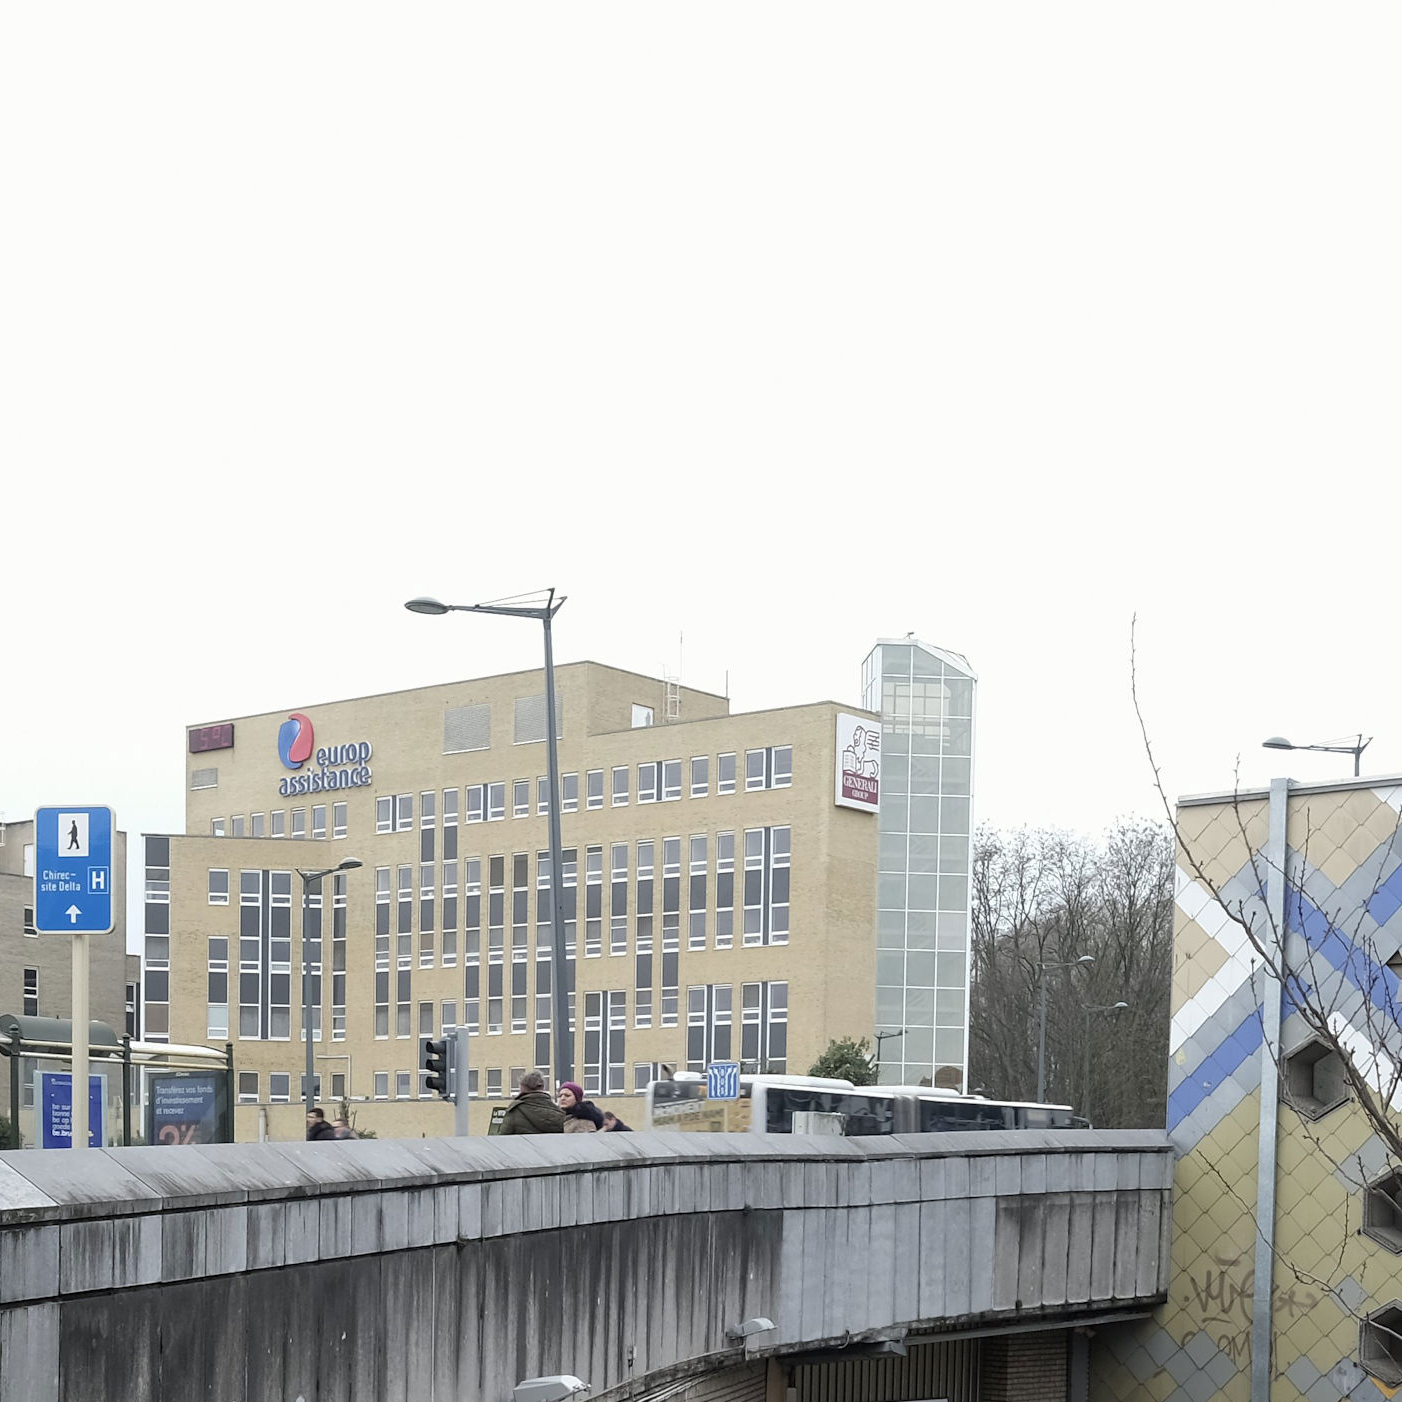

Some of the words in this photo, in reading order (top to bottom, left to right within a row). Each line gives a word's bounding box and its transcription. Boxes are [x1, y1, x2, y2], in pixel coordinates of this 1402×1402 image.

[316, 740, 372, 768] europ
[278, 765, 373, 797] assistance
[843, 774, 877, 793] GENERALI
[42, 870, 77, 881] Chirec-
[91, 871, 105, 890] H
[40, 881, 57, 892] site
[58, 881, 81, 892] Delta
